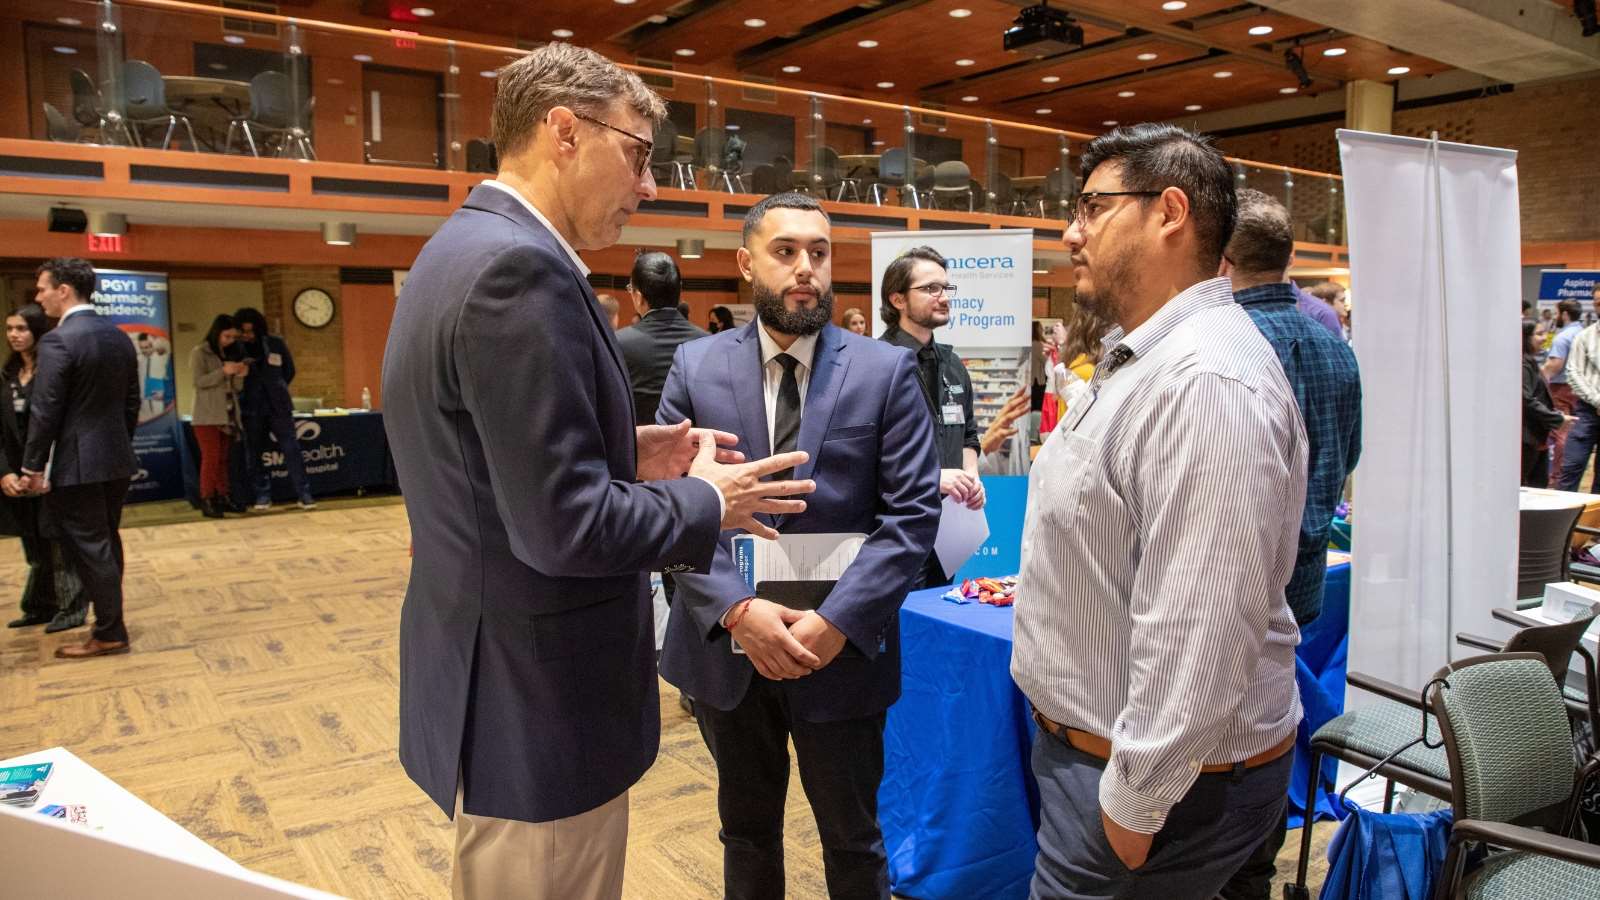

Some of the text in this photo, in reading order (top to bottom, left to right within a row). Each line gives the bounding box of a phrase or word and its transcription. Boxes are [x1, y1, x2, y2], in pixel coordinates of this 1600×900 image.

[88, 236, 121, 252] EXIT
[101, 279, 137, 292] PGY1
[1557, 288, 1593, 297] Pharmac
[95, 304, 156, 317] esidency
[950, 298, 984, 312] macy
[960, 313, 1015, 330] Program
